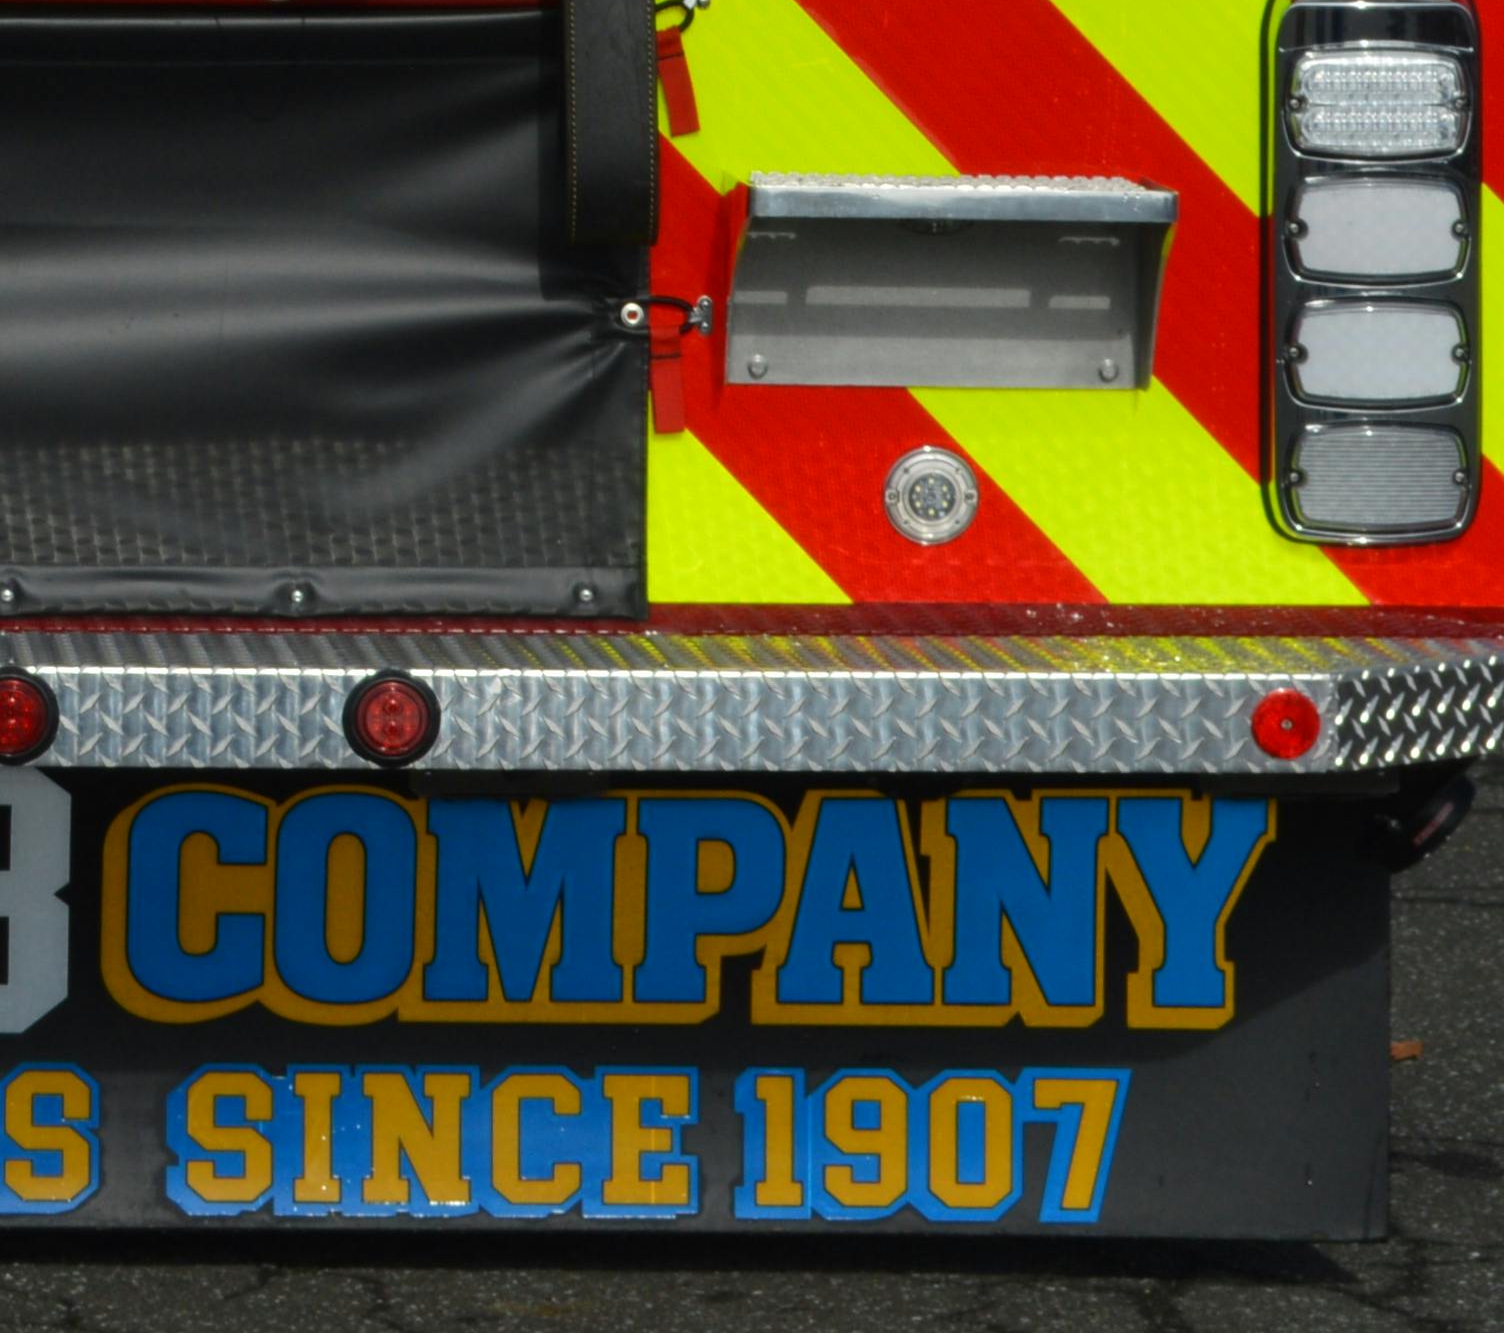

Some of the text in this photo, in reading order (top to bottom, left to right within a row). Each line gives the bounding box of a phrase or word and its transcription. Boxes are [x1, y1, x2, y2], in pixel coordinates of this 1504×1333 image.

[100, 783, 1278, 1027] COMPANY
[165, 1064, 701, 1218] SINCE
[734, 1066, 1132, 1222] 1907
